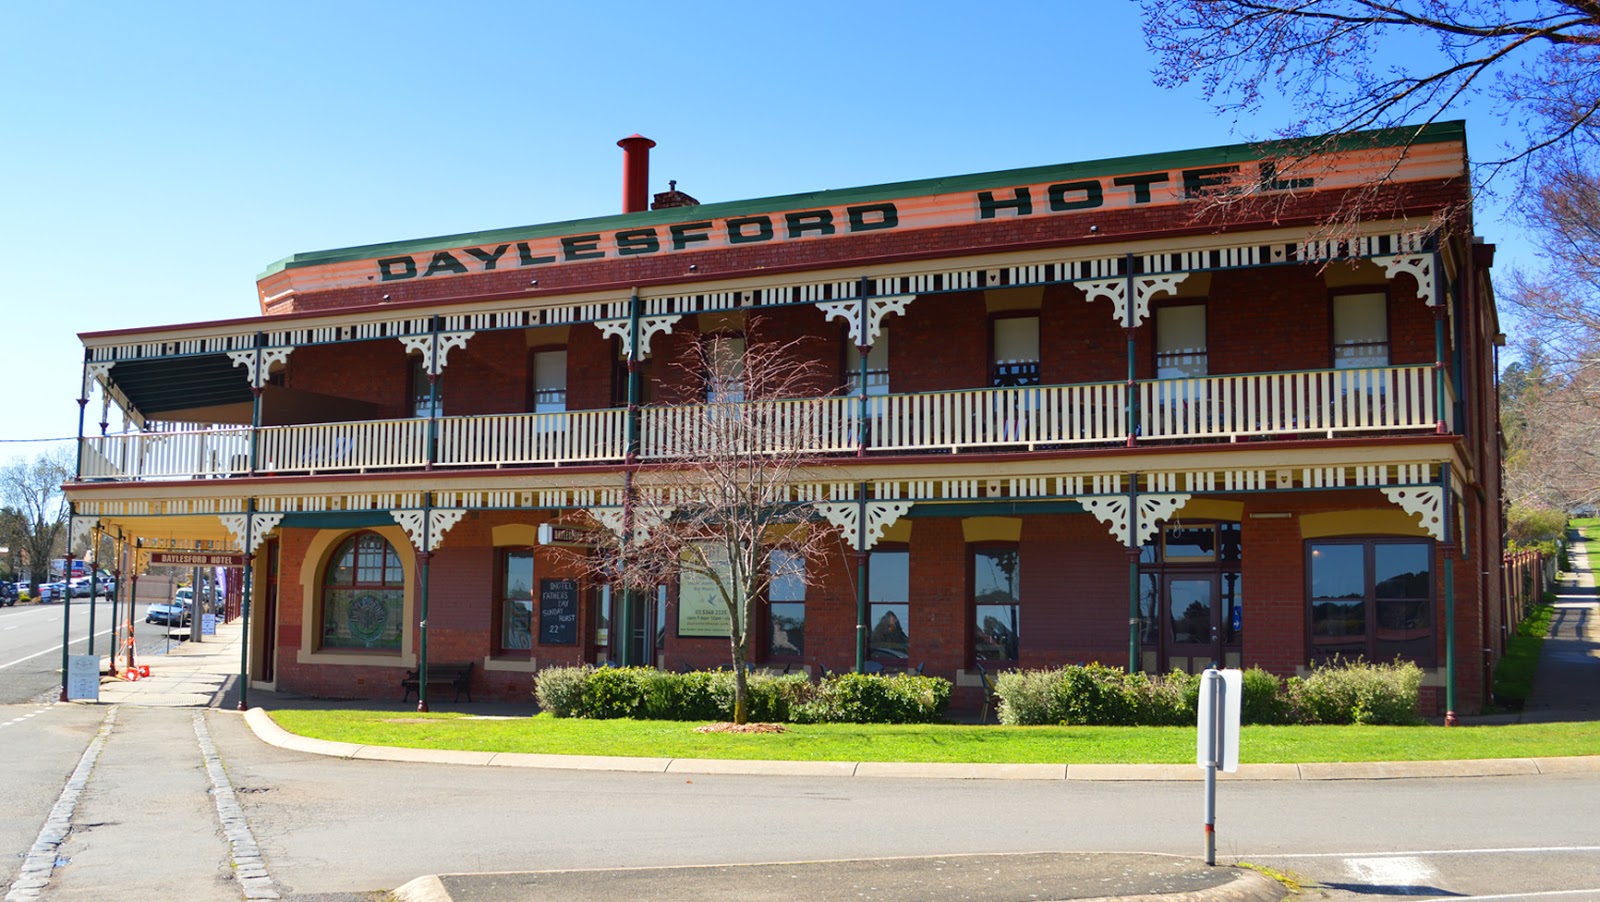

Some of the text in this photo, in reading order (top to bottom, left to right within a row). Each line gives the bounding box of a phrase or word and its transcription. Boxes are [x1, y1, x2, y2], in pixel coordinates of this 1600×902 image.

[376, 162, 1315, 282] DAYLESFORD HOTEL
[161, 555, 232, 564] DAYLESFORD HOTEL
[558, 600, 569, 608] DAY
[542, 608, 564, 617] SUNDAY
[559, 614, 576, 622] ROAST
